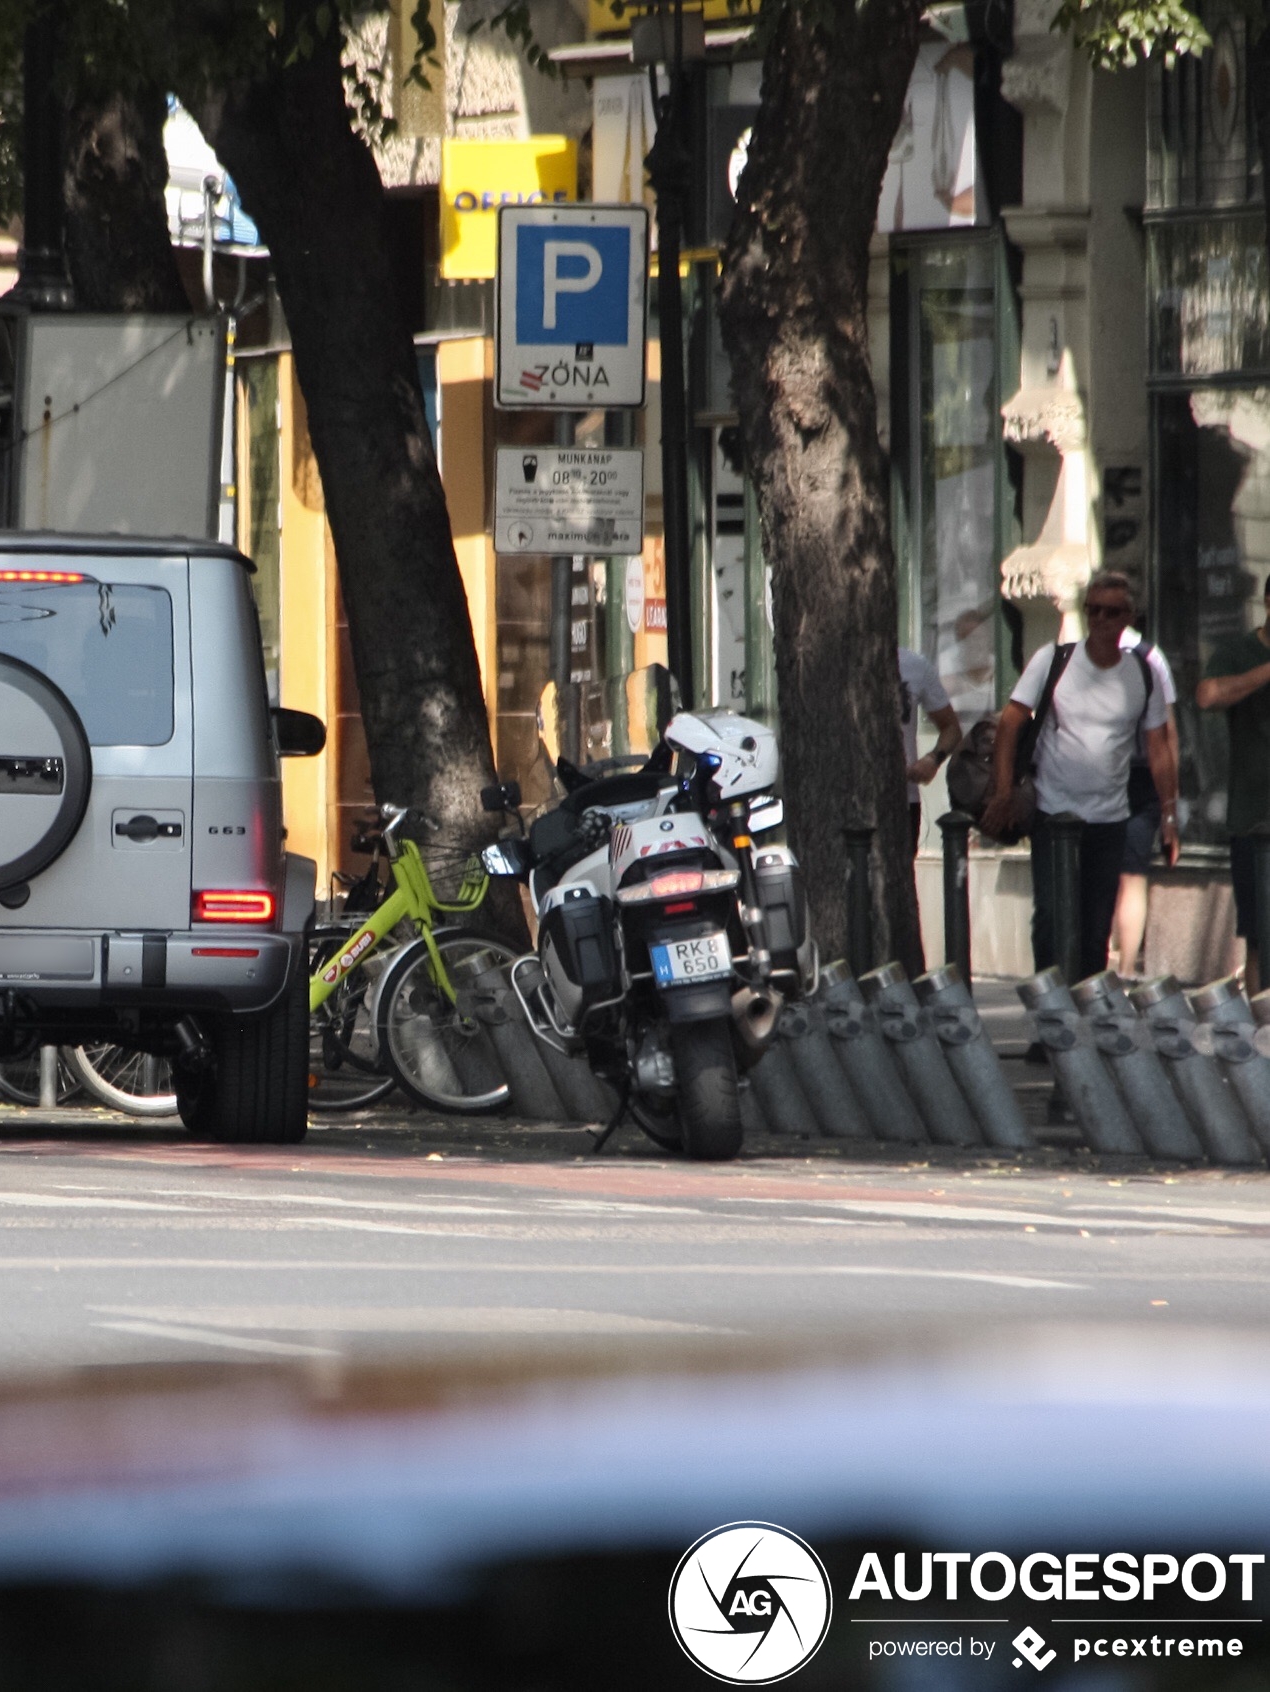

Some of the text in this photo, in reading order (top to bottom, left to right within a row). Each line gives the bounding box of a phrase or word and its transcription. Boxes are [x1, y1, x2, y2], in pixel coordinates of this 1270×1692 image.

[543, 240, 603, 330] P
[558, 453, 613, 465] MUNKANAP
[659, 965, 669, 976] H
[683, 955, 719, 975] 650
